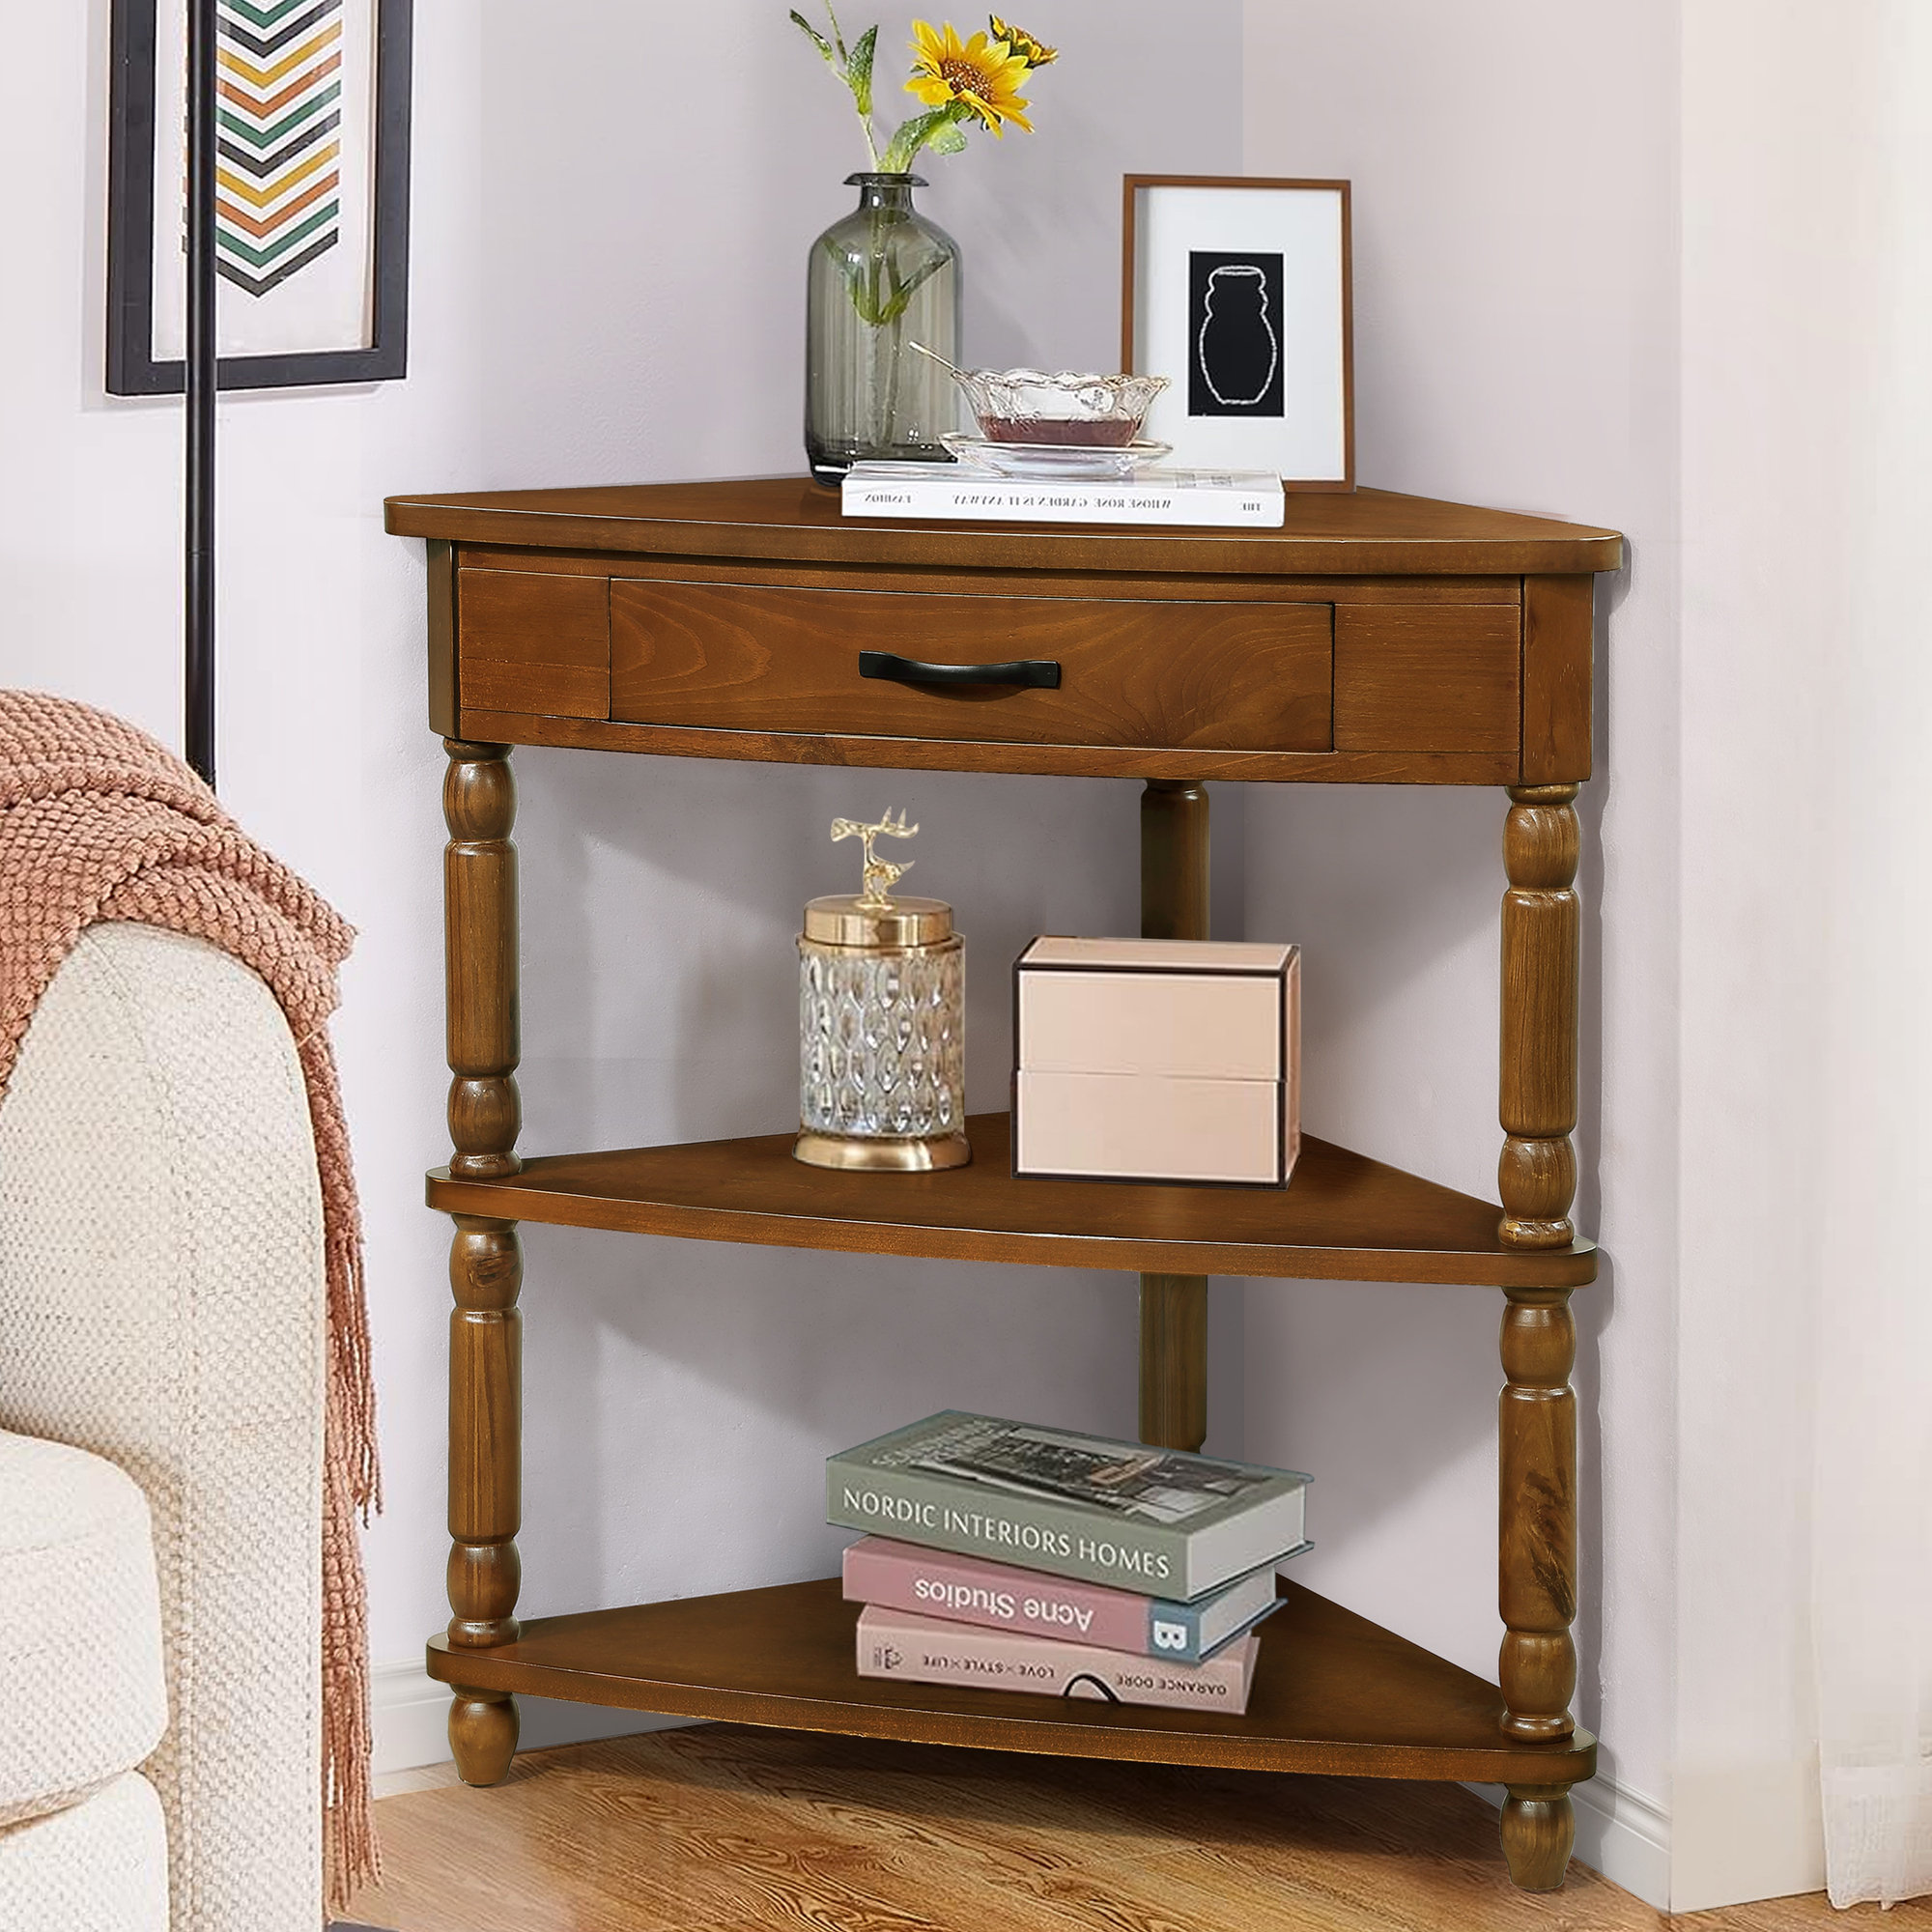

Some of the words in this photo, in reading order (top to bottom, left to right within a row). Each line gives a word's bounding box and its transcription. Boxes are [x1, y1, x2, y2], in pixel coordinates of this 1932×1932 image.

[842, 1486, 936, 1527] NORDIC
[943, 1510, 1071, 1558] INTERIORS
[1079, 1538, 1171, 1579] HOMES
[914, 1577, 1015, 1619] Studios
[1024, 1600, 1094, 1633] Acne
